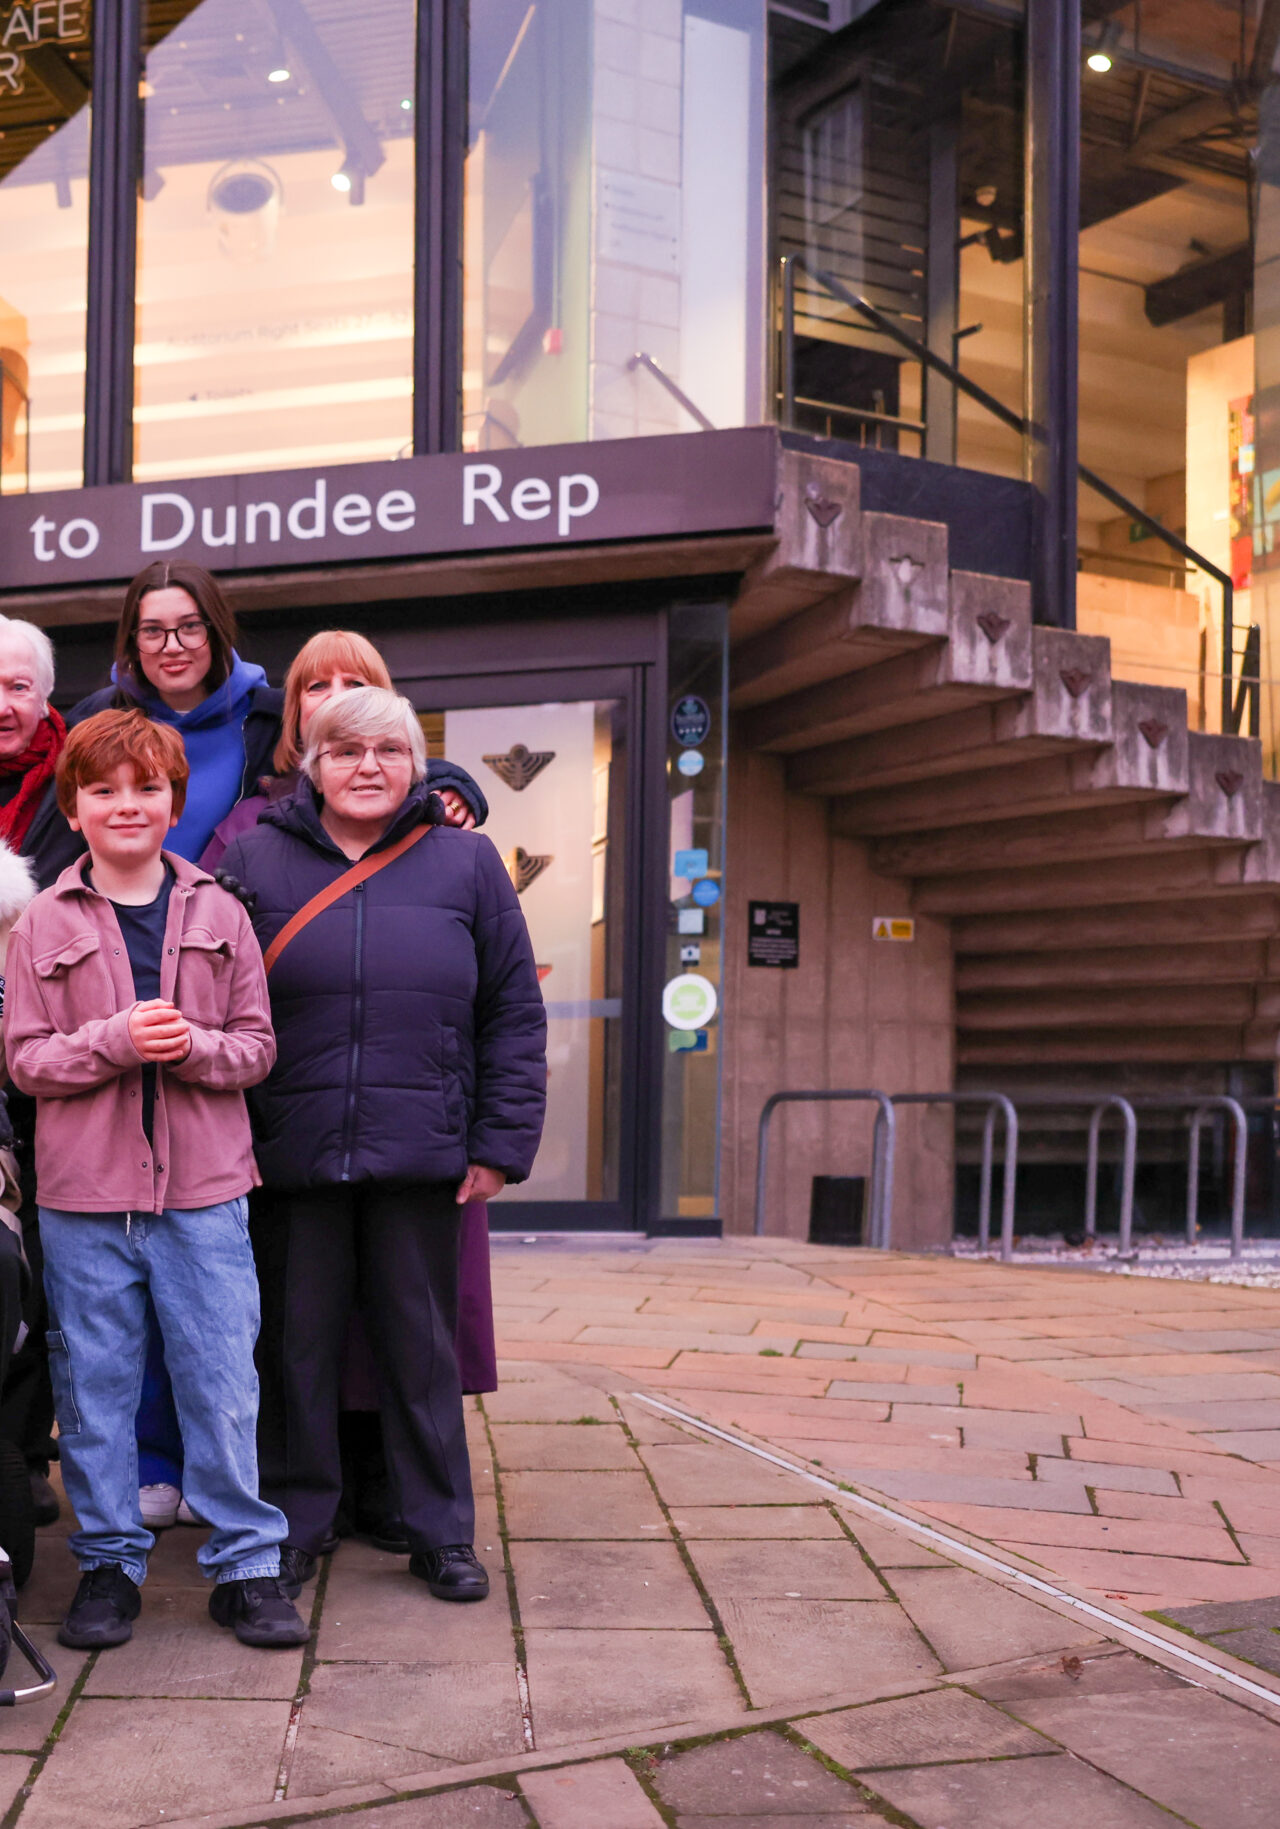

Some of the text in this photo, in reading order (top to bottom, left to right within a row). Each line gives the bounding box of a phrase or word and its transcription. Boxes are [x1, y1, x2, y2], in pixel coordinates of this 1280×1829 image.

[29, 515, 99, 561] to
[141, 479, 416, 552] Dundee
[462, 463, 600, 536] Rep
